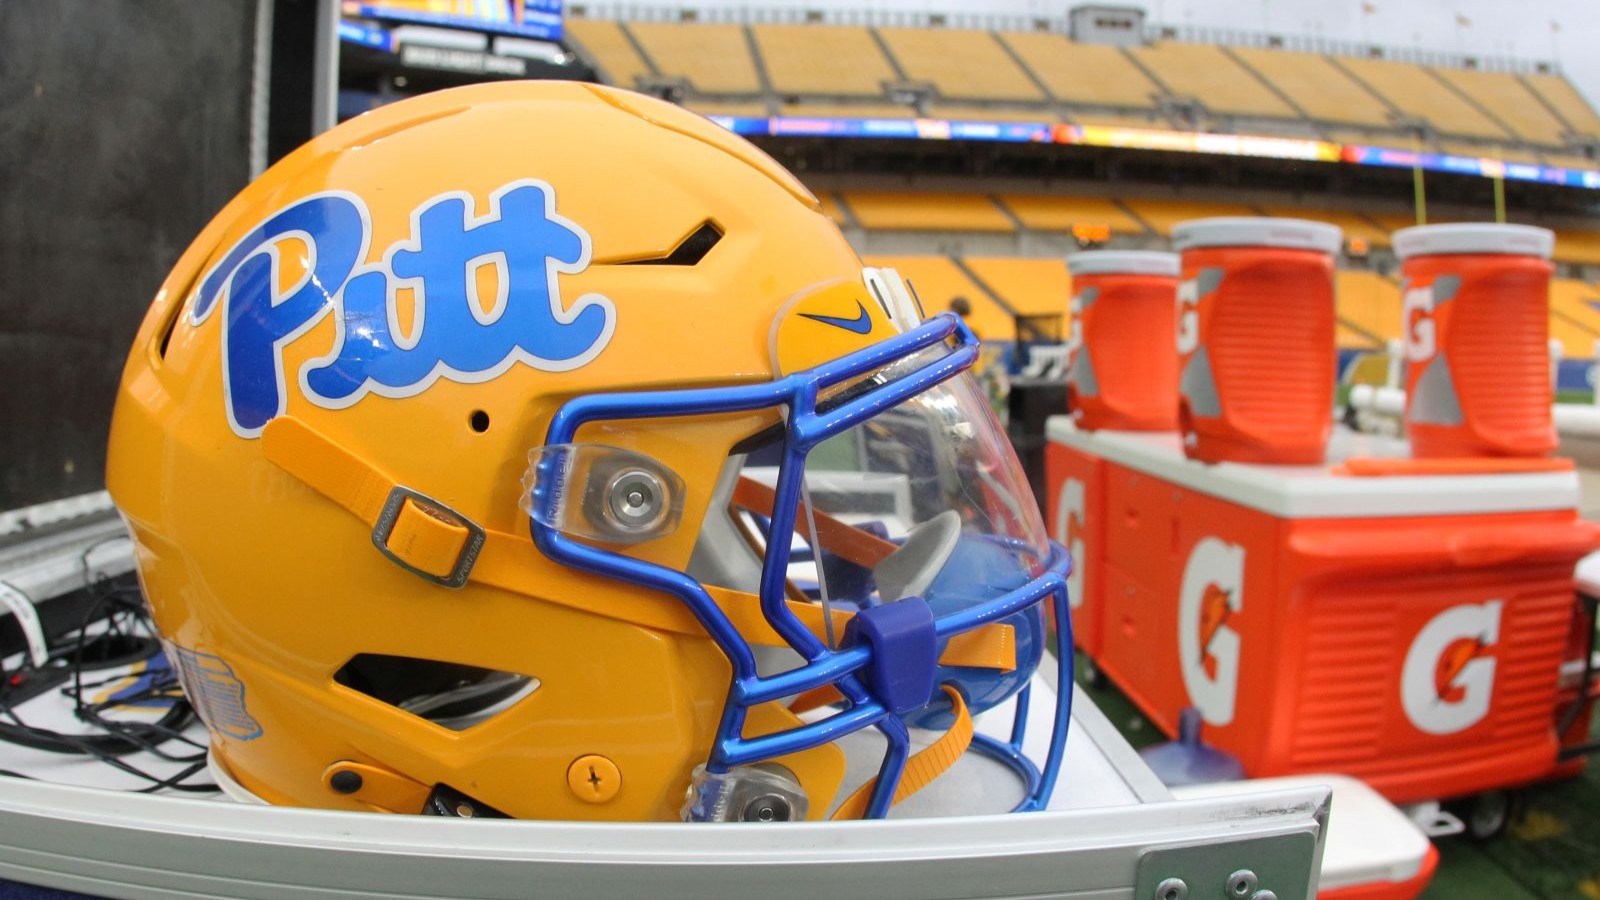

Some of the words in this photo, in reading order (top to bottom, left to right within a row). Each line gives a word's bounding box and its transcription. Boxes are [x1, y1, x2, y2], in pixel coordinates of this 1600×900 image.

[190, 178, 616, 438] Pitt
[1403, 287, 1436, 361] G
[1180, 537, 1246, 726] G
[1402, 600, 1506, 734] G
